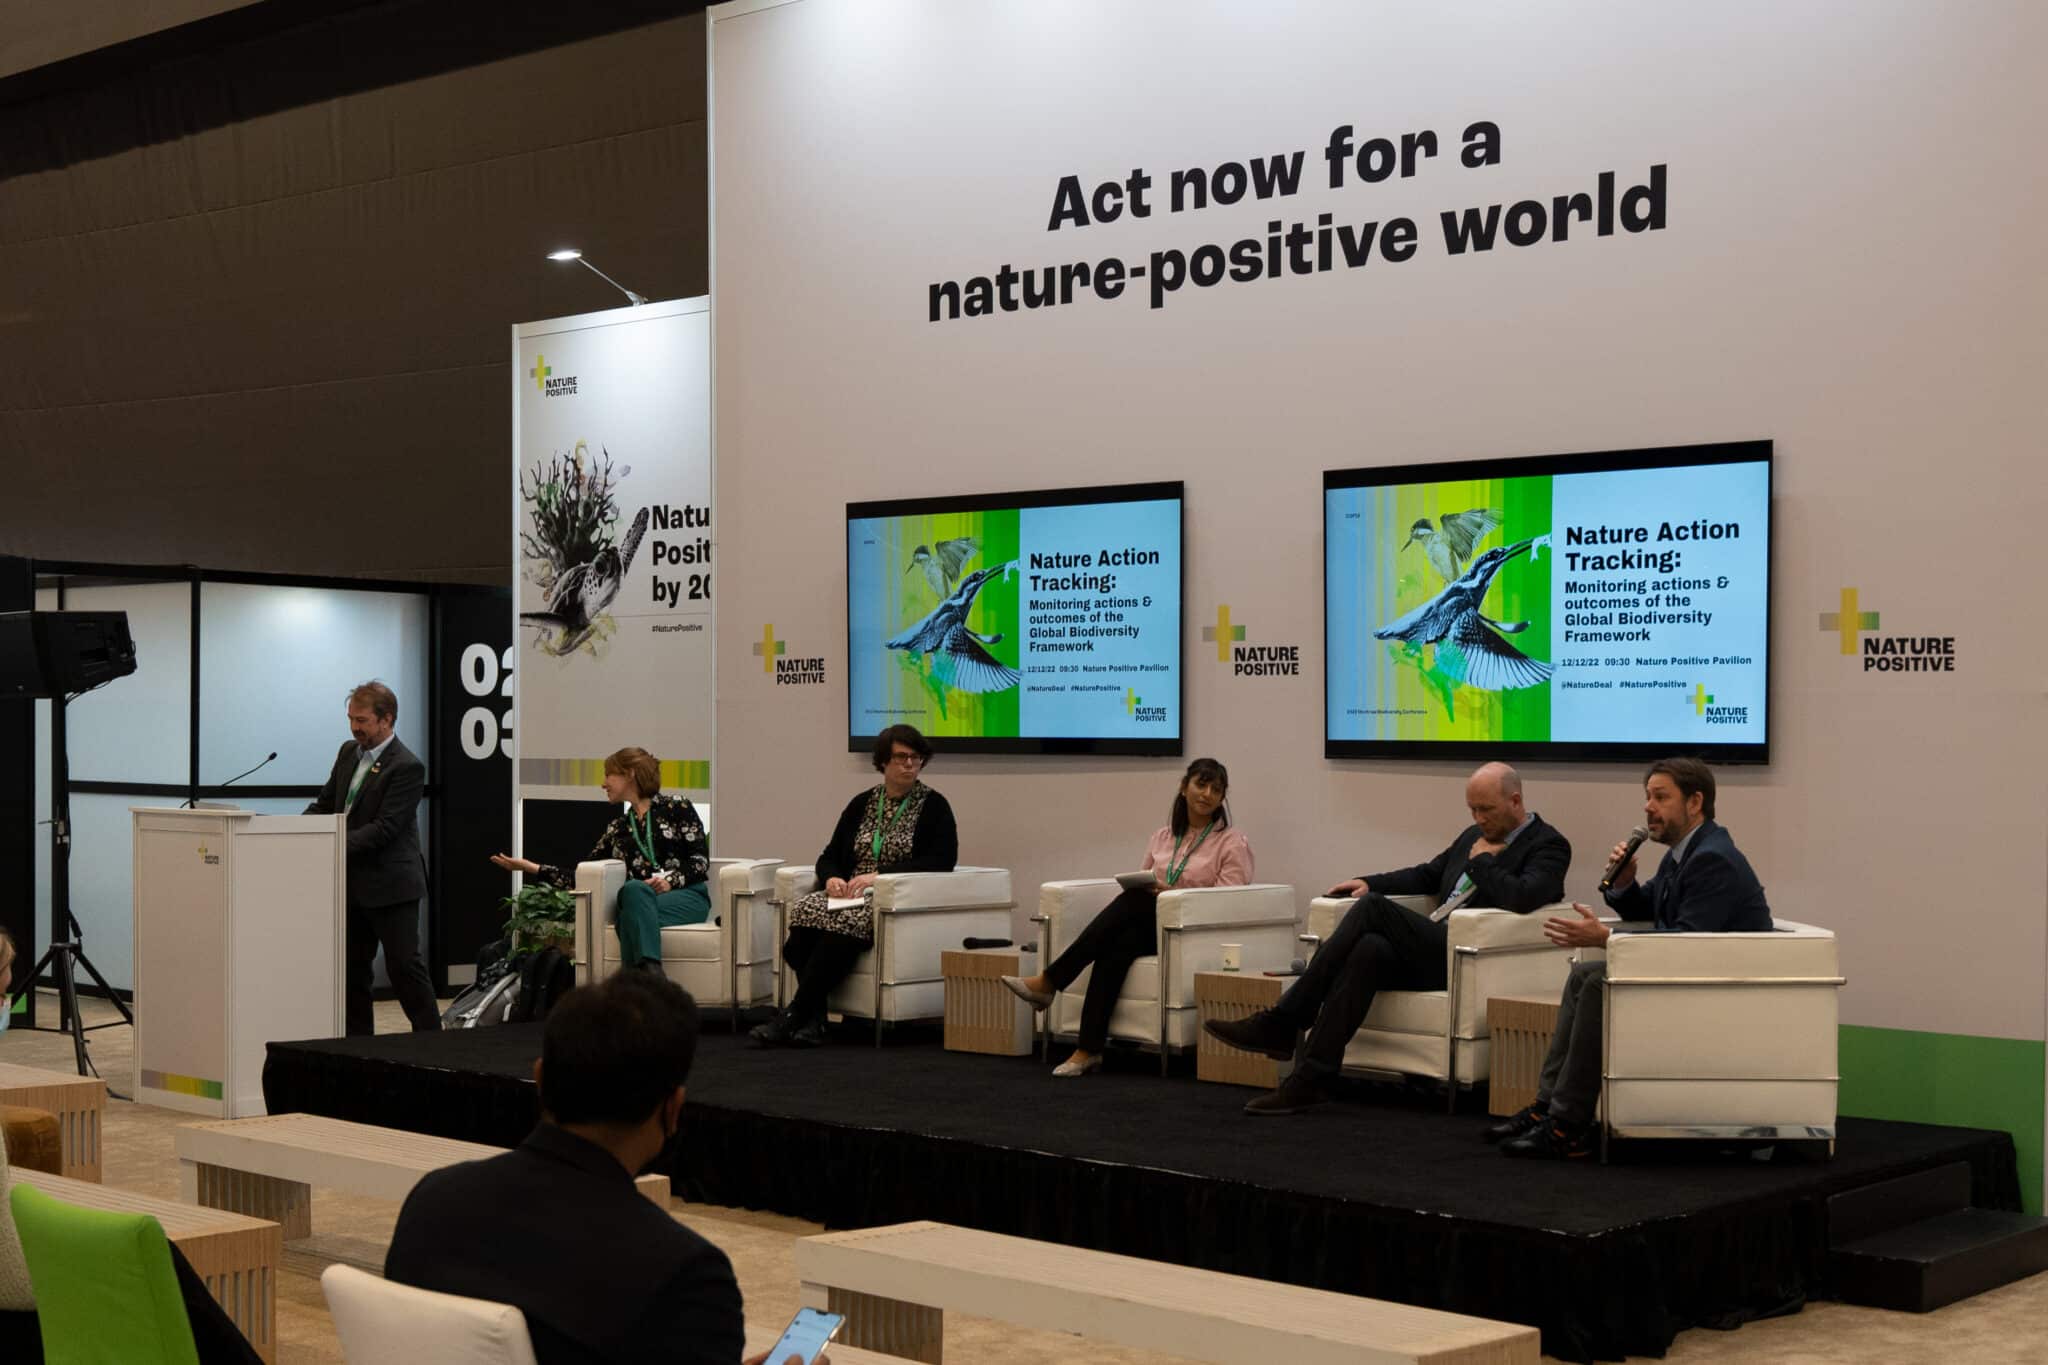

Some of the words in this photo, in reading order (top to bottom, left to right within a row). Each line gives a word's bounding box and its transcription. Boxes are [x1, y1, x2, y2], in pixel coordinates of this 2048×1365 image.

[1047, 167, 1151, 231] Act
[1170, 151, 1305, 212] now
[1325, 125, 1438, 189] for
[1461, 120, 1501, 168] a
[929, 213, 1418, 322] nature-positive
[1441, 164, 1668, 257] world
[546, 376, 577, 389] NATURE
[546, 386, 577, 397] POSITIVE
[652, 504, 710, 530] Natu
[1566, 525, 1648, 546] Nature
[1656, 519, 1739, 542] Action
[1030, 552, 1092, 569] Nature
[1098, 548, 1160, 567] Action
[1565, 548, 1681, 573] Tracking:
[1029, 572, 1117, 594] Tracking:
[1565, 579, 1647, 594] Monitoring
[1651, 577, 1711, 591] actions
[1716, 576, 1729, 589] &
[652, 575, 681, 608] by
[1029, 598, 1091, 612] Monitoring
[1094, 597, 1139, 609] actions
[1142, 596, 1152, 607] &
[1565, 597, 1640, 610] outcomes
[1645, 594, 1660, 608] of
[1665, 594, 1691, 607] the
[1029, 613, 1086, 625] outcomes
[1089, 611, 1101, 623] of
[1104, 611, 1124, 623] the
[1565, 612, 1613, 626] Global
[1618, 610, 1713, 626] Biodiversity
[652, 624, 703, 633] #NaturePositive
[1029, 626, 1066, 639] Global
[1069, 625, 1140, 639] Biodiversity
[1565, 628, 1651, 643] Framework
[1029, 640, 1094, 653] Framework
[1864, 637, 1955, 655] NATURE
[1235, 646, 1299, 662] NATURE
[1561, 658, 1599, 667] 12/12/22
[1604, 657, 1631, 666] 09:30
[1635, 657, 1668, 666] Nature
[1670, 656, 1710, 666] Positive
[1712, 656, 1752, 665] Pavilion
[777, 658, 825, 673] NATURE
[1082, 664, 1107, 673] Nature
[1109, 664, 1138, 672] Positive
[1140, 664, 1169, 672] Pavilion
[1235, 663, 1299, 676] POSITIVE
[1864, 657, 1955, 672] POSITIVE
[777, 672, 825, 685] POSITIVE
[1619, 680, 1688, 689] #NaturePositive
[1070, 684, 1121, 692] #NaturePositive
[1135, 707, 1167, 715] NATURE
[1706, 707, 1748, 716] NATURE
[1706, 716, 1748, 724] POSITIVE
